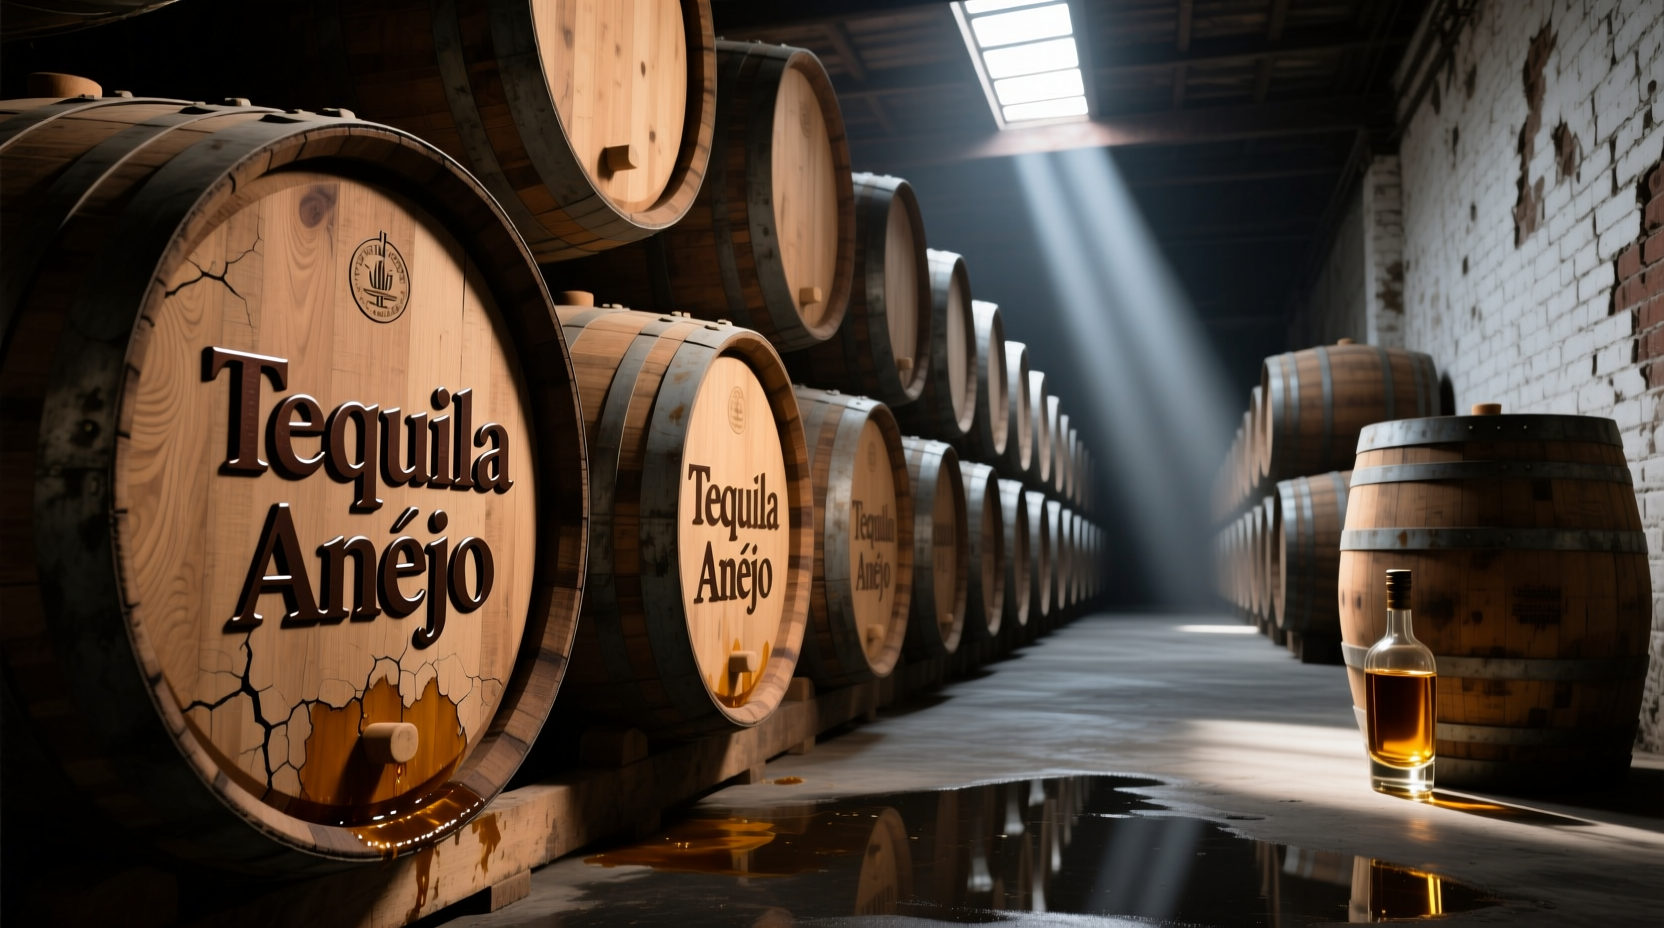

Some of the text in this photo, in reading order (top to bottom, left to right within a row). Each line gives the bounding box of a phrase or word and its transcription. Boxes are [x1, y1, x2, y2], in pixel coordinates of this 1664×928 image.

[201, 346, 513, 514] Tequila
[688, 463, 779, 541] Tequila
[222, 502, 494, 650] Anéjo
[693, 541, 773, 615] Anéjo
[855, 551, 891, 602] Anéjo
